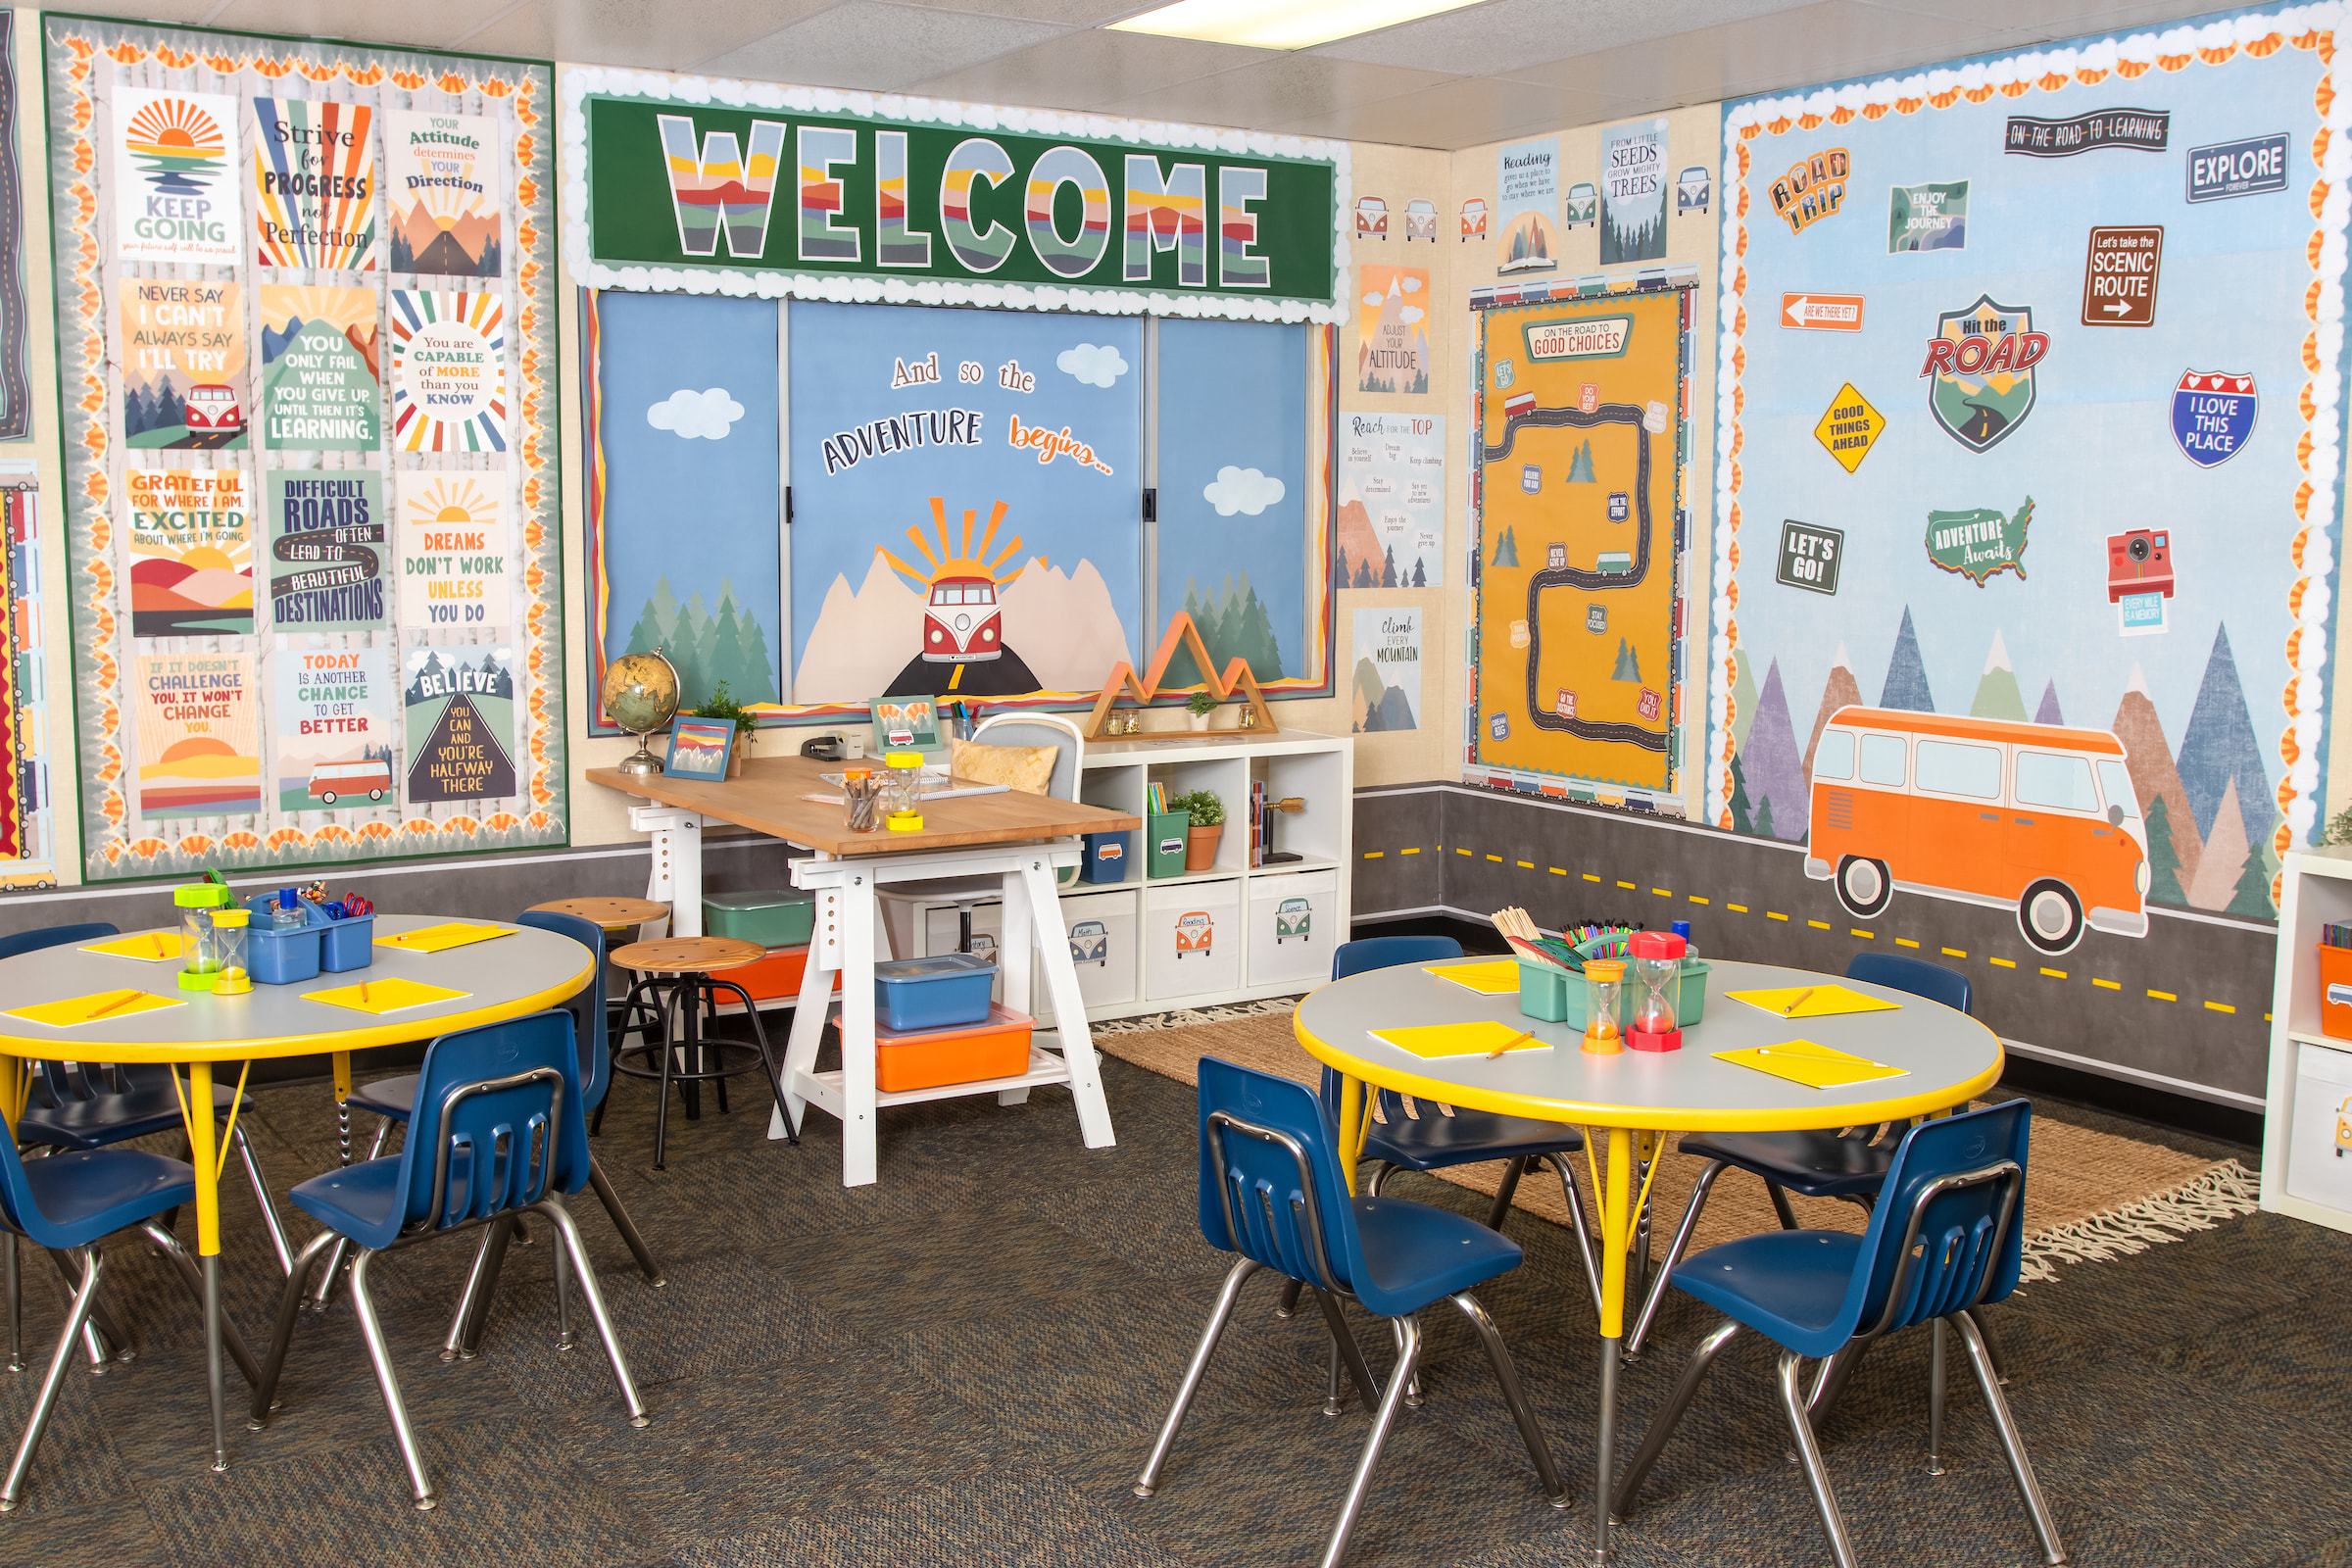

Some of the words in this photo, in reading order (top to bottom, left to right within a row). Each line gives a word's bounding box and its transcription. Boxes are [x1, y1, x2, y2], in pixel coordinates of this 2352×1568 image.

[273, 121, 355, 147] Strive
[2011, 125, 2026, 144] ON
[2031, 126, 2050, 146] THE
[2055, 125, 2082, 146] ROAD
[2088, 120, 2102, 139] TO
[2109, 117, 2162, 140] LEARNING
[1611, 138, 1631, 148] FROM
[1635, 133, 1658, 144] LITTLE
[301, 149, 329, 171] for
[1504, 153, 1552, 170] Reading
[1612, 144, 1656, 168] SEEDS
[1608, 168, 1630, 178] GROW
[1634, 163, 1660, 174] MIGHTY
[2193, 146, 2282, 186] EXPLORE
[265, 172, 367, 200] PROGRESS
[1611, 174, 1656, 197] TREES
[1773, 151, 1847, 211] ROAD
[2226, 181, 2249, 192] FOREVER
[657, 113, 1271, 288] WELCOME
[1786, 182, 1843, 231] TRIP
[1913, 192, 1947, 205] ENJOY
[146, 196, 211, 220] KEEP
[302, 203, 332, 220] not
[1920, 206, 1938, 217] THE
[134, 218, 225, 242] GOING
[1905, 218, 1952, 230] JOURNEY
[265, 221, 368, 248] Perfection
[2097, 236, 2118, 249] Let's
[2120, 236, 2137, 248] take
[2140, 236, 2154, 248] the
[2093, 252, 2153, 272] SCENIC
[138, 286, 188, 301] NEVER
[194, 288, 223, 304] SAY
[2093, 276, 2149, 297] ROUTE
[140, 305, 146, 323] I
[155, 305, 225, 327] CAN'T
[1804, 307, 1815, 318] ARE
[1815, 307, 1824, 318] WE
[1825, 308, 1840, 318] THERE
[1383, 325, 1405, 336] ADJUST
[1558, 327, 1573, 336] THE
[1575, 326, 1596, 335] ROAD
[1963, 320, 1982, 334] Hit
[1985, 318, 2007, 331] the
[133, 330, 197, 347] ALWAYS
[203, 333, 232, 347] SAY
[300, 335, 343, 352] YOU
[423, 337, 449, 348] You
[1386, 338, 1402, 348] YOUR
[1535, 337, 1564, 356] GOOD
[1568, 332, 1620, 353] CHOICES
[139, 348, 176, 369] I'LL
[185, 349, 227, 371] TRY
[285, 354, 323, 368] ONLY
[329, 355, 358, 369] FAIL
[414, 352, 484, 363] CAPABLE
[1369, 350, 1416, 369] ALTITUDE
[1921, 333, 2050, 376] ROAD
[300, 371, 344, 385] WHEN
[419, 367, 434, 377] of
[436, 367, 479, 377] MORE
[894, 355, 940, 387] And
[960, 364, 981, 382] so
[1000, 363, 1033, 391] the
[274, 387, 306, 401] YOU
[311, 388, 346, 402] GIVE
[351, 389, 369, 403] UP.
[421, 380, 451, 390] than
[455, 382, 478, 393] you
[426, 394, 474, 405] KNOW
[2190, 397, 2195, 412] I
[2201, 398, 2238, 416] LOVE
[274, 405, 308, 416] UNTIL
[312, 405, 342, 416] THEN
[346, 405, 365, 416] IT'S
[1834, 405, 1864, 420] GOOD
[270, 417, 373, 440] LEARNING.
[1353, 416, 1385, 437] Reach
[1411, 419, 1432, 435] TOP
[1829, 419, 1870, 436] THINGS
[2195, 416, 2229, 432] THIS
[824, 410, 983, 473] ADVENTURE
[1011, 417, 1110, 473] begins...
[1833, 435, 1868, 451] AHEAD
[2185, 432, 2233, 452] PLACE
[132, 475, 244, 492] GRATEFUL
[284, 480, 364, 499] DIFFICULT
[132, 495, 158, 507] FOR
[164, 495, 209, 508] WHERE
[214, 496, 217, 507] I
[221, 496, 244, 508] AM.
[134, 512, 243, 530] EXCITED
[284, 499, 369, 533] ROADS
[134, 533, 164, 545] ABOUT
[168, 533, 196, 545] WHERE
[200, 531, 213, 542] I'M
[335, 527, 371, 543] OFTEN
[424, 533, 485, 551] DREAMS
[1935, 518, 2003, 551] ADVENTURE
[291, 545, 319, 560] LEAD
[325, 546, 343, 561] TO
[1788, 531, 1835, 561] LET'S
[1963, 540, 2014, 564] Awaits
[406, 557, 453, 575] DON'T
[461, 557, 504, 574] WORK
[1792, 557, 1825, 582] GO!
[291, 565, 368, 591] BEAUTIFUL
[428, 581, 483, 599] UNLESS
[274, 578, 383, 623] DESTINATIONS
[2125, 598, 2143, 610] EVERY
[2145, 596, 2158, 608] MILE
[428, 605, 458, 622] YOU
[466, 605, 484, 621] DO
[1592, 611, 1602, 619] STAY
[2125, 611, 2130, 621] IS
[2132, 611, 2135, 619] A
[2135, 609, 2160, 619] MEMORY
[1388, 636, 1409, 645] EVERY
[303, 654, 360, 669] TODAY
[1377, 647, 1417, 662] MOUNTAIN
[299, 672, 310, 684] IS
[314, 671, 367, 684] ANOTHER
[420, 671, 498, 698] BELIEVE
[298, 686, 368, 702] CHANCE
[1644, 694, 1656, 707] YOU
[314, 705, 327, 715] TO
[333, 704, 354, 715] GET
[450, 707, 469, 717] YOU
[1640, 702, 1650, 714] DID
[1650, 706, 1657, 717] IT
[300, 717, 368, 735] BETTER
[450, 719, 471, 732] CAN
[451, 733, 470, 744] AND
[438, 745, 484, 760] YOU'RE
[430, 760, 493, 778] HALFWAY
[441, 778, 483, 793] THERE
[1183, 917, 1204, 928] Reading
